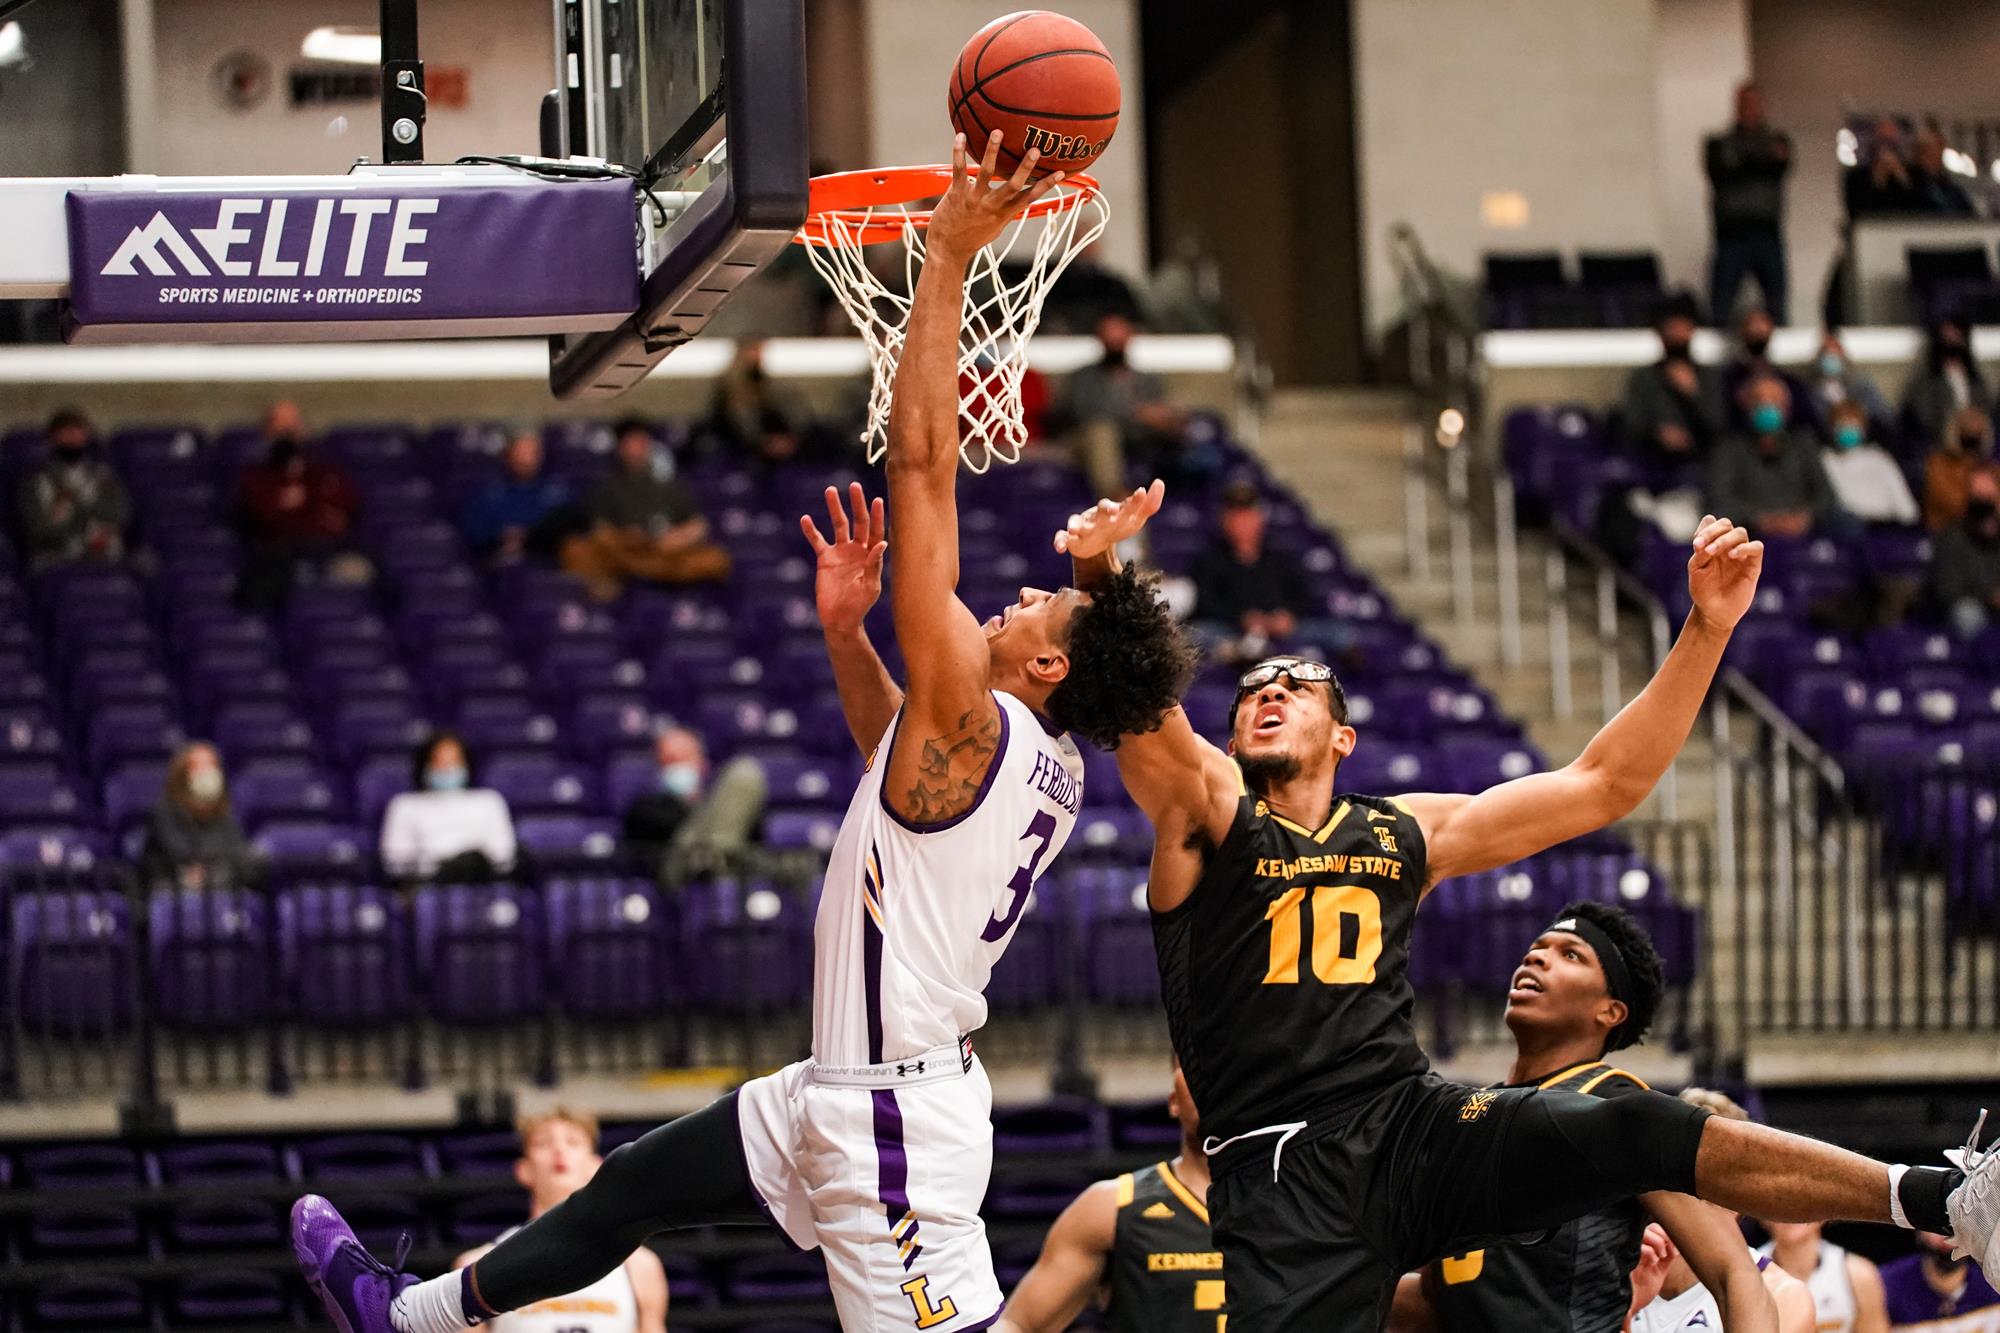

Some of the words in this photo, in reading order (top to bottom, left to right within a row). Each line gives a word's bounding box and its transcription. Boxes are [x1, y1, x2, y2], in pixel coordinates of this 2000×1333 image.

[190, 199, 440, 277] ELITE
[159, 288, 219, 303] SPORTS
[222, 288, 301, 303] MEDICINE
[316, 288, 423, 303] ORTHOPEDICS
[1027, 750, 1083, 817] FERGUSO
[980, 809, 1057, 943] 3
[1350, 855, 1403, 881] STATE
[1262, 885, 1384, 985] 10
[1147, 1252, 1224, 1272] KENNES
[900, 1274, 960, 1331] L
